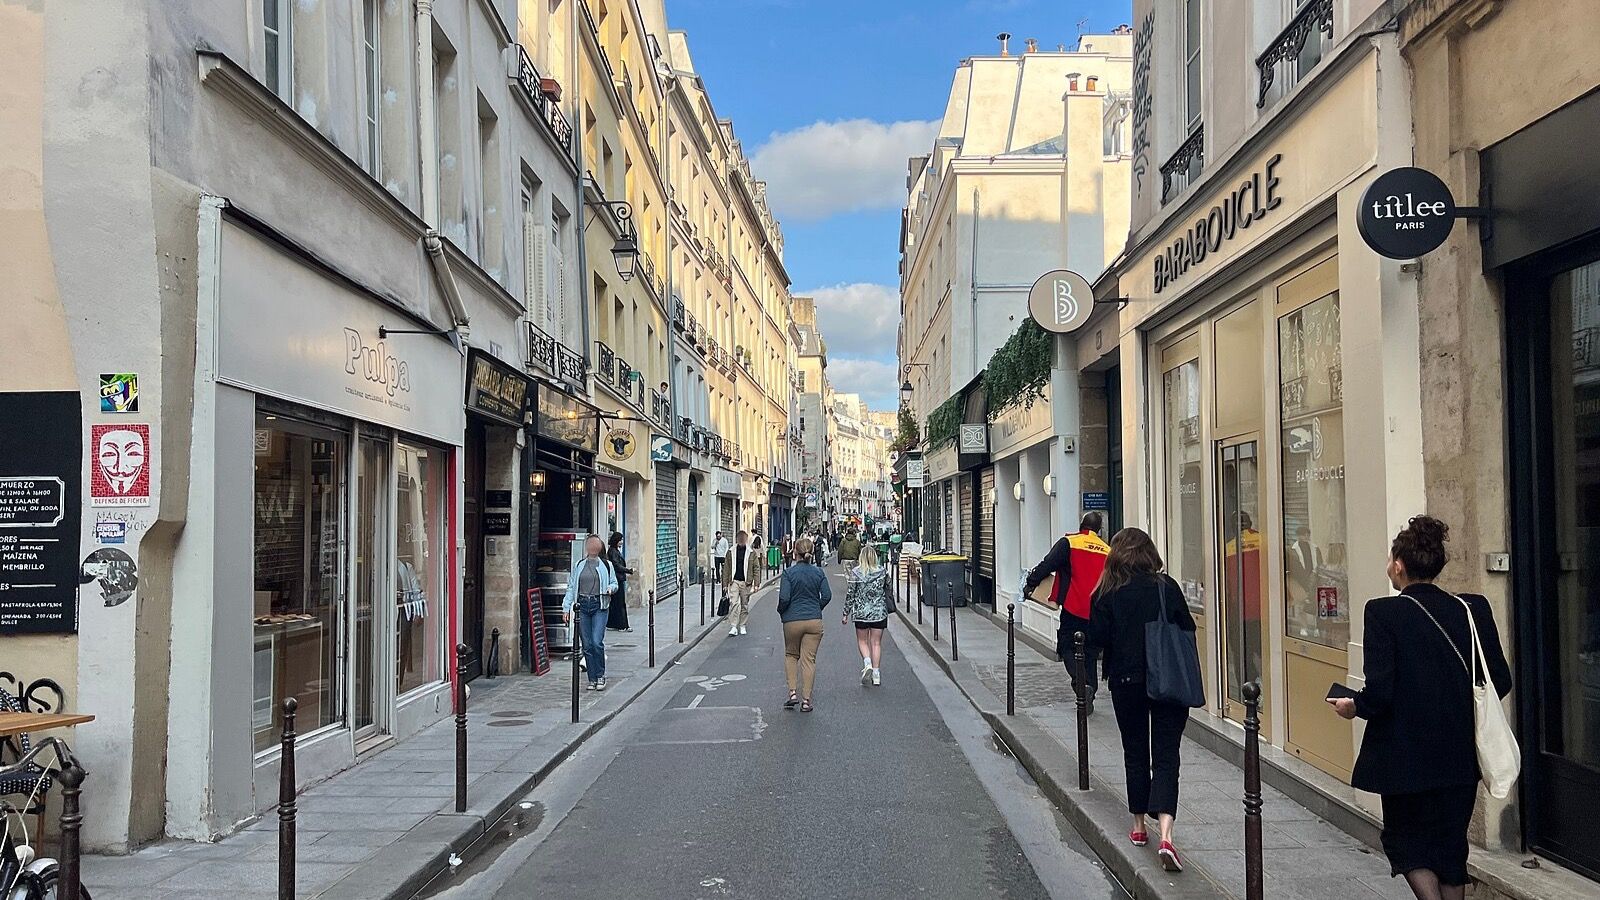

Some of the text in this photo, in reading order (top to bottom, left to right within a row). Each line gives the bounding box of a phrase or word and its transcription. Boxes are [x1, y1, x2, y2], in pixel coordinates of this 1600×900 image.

[1372, 193, 1446, 219] titlee
[1153, 153, 1283, 294] BARABOUCLE
[1395, 221, 1425, 231] PARIS
[344, 326, 411, 397] Pulpa
[1296, 464, 1344, 483] BARABOUCLE
[1087, 544, 1105, 552] DHL
